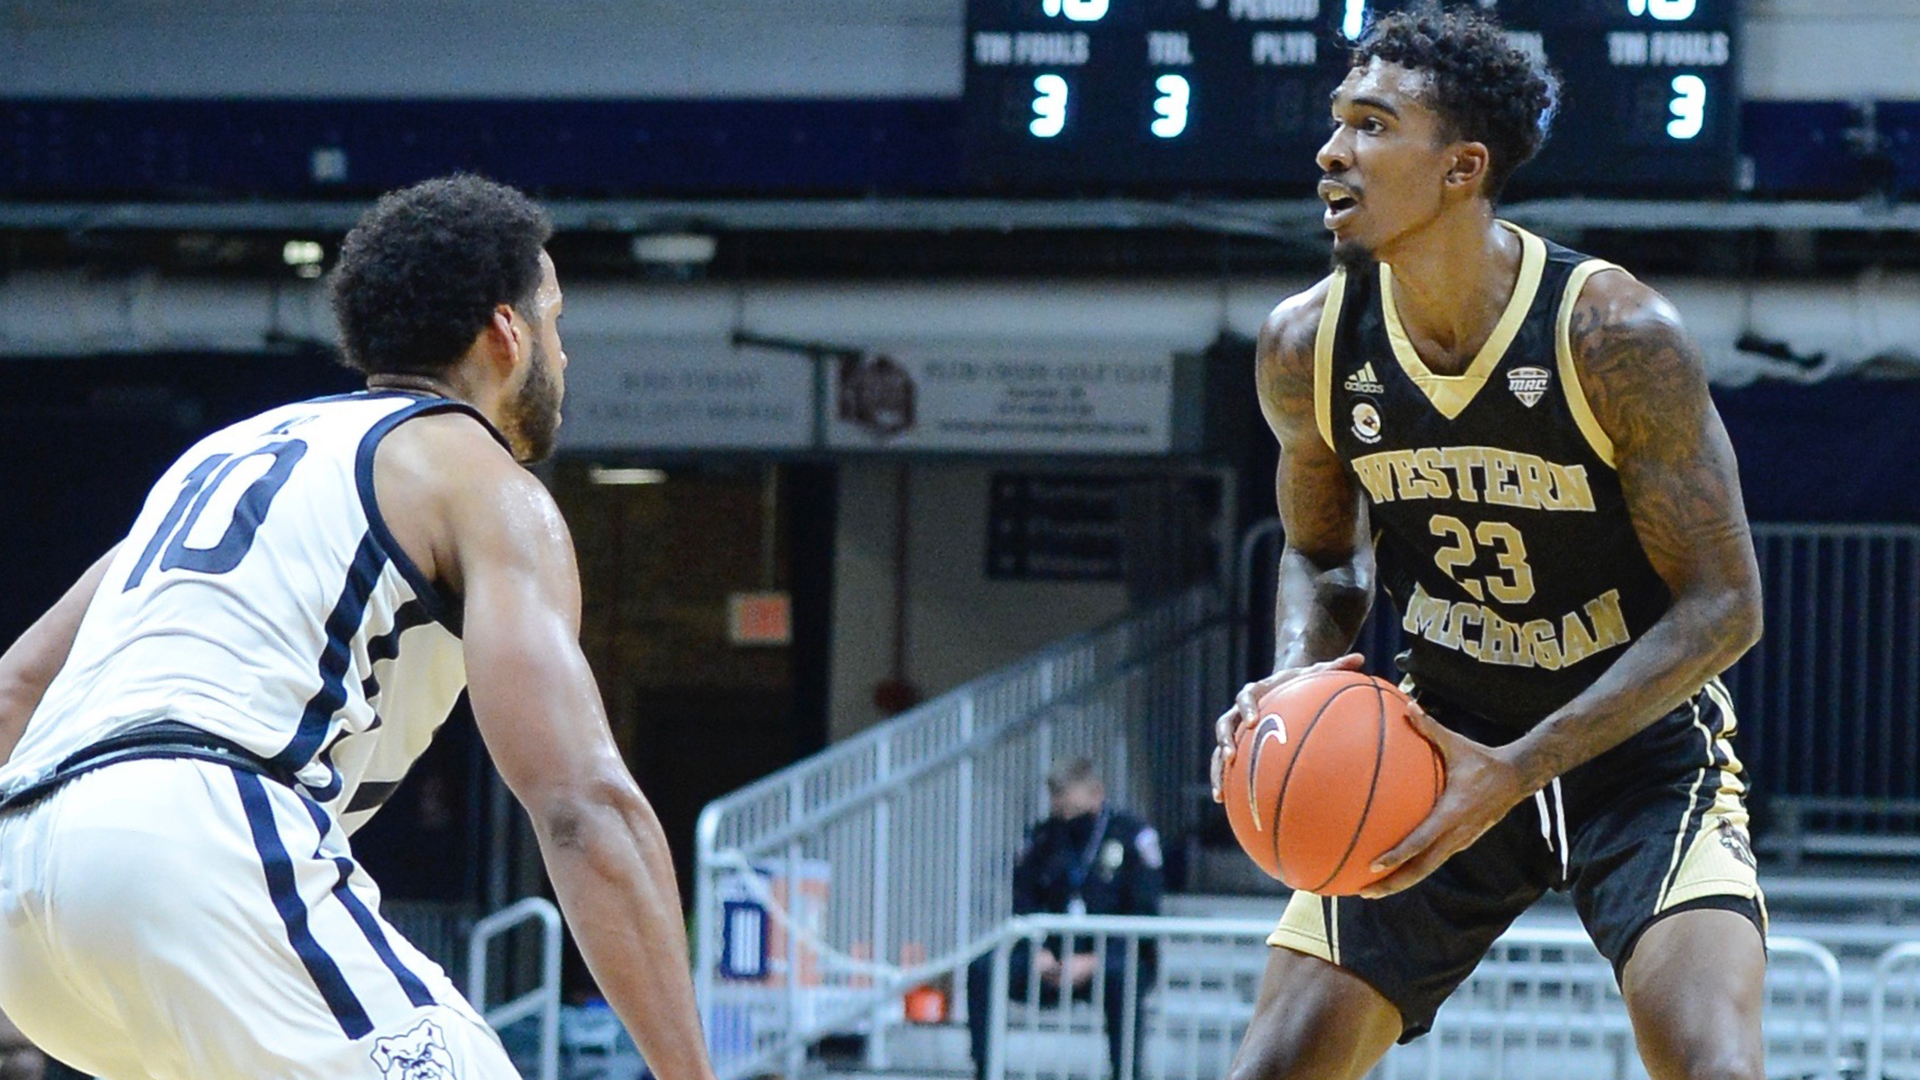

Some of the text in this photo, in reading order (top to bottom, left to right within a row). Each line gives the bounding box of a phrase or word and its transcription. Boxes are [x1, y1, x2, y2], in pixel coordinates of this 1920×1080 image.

[1015, 31, 1090, 65] FOULS
[1651, 31, 1730, 65] FOULS
[1029, 74, 1068, 138] 3
[1151, 74, 1190, 138] 3
[1666, 75, 1706, 139] 3
[1344, 381, 1384, 394] adidas
[1509, 379, 1548, 391] MAC
[1351, 446, 1597, 512] WESTERN
[121, 438, 308, 594] 10
[1429, 514, 1536, 604] 23
